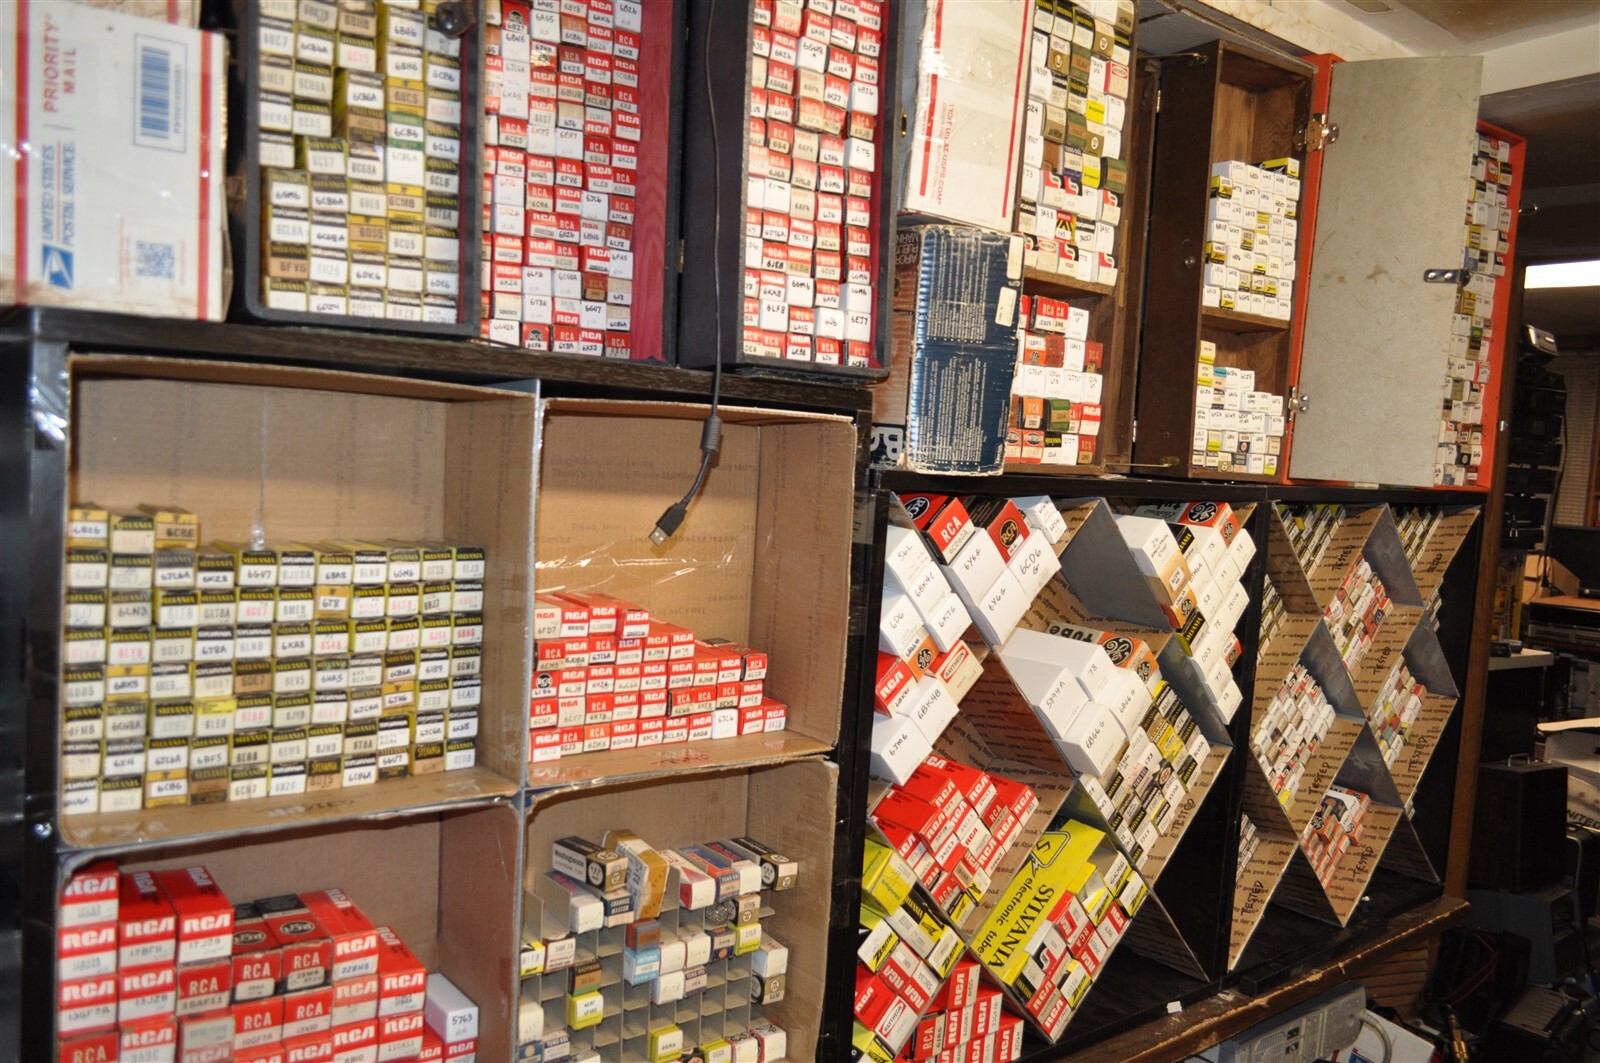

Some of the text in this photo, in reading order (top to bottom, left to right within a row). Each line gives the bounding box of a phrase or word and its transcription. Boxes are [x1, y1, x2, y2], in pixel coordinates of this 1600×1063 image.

[810, 12, 830, 24] RCA
[590, 25, 611, 38] RCA
[775, 36, 796, 47] RCA
[43, 18, 60, 113] PRIORITY
[588, 55, 609, 67] RCA
[615, 59, 635, 71] RCA
[62, 48, 76, 94] MAIL
[532, 70, 556, 81] RCA
[560, 73, 582, 85] RCA
[531, 99, 554, 111] RCA
[586, 123, 609, 134] RCA
[501, 149, 523, 160] RCA
[531, 157, 553, 168] RCA
[42, 144, 54, 240] UNITED STATES
[62, 140, 75, 246] POSTAL SERVICE
[1056, 306, 1064, 317] CA
[941, 516, 962, 543] RCA
[627, 613, 648, 621] RCA
[565, 643, 587, 651] RCA
[672, 663, 692, 672] RCA
[1373, 647, 1391, 674] TESTED
[591, 667, 612, 676] RCA
[619, 667, 640, 675] RCA
[880, 671, 904, 699] RCA
[614, 723, 635, 733] RCA
[642, 721, 662, 730] RCA
[667, 718, 686, 727] RCA
[693, 716, 712, 725] RCA
[536, 734, 559, 744] RCA
[927, 756, 946, 768] CA
[1308, 761, 1329, 795] TESTED
[935, 780, 955, 807] RCA
[969, 775, 989, 801] RCA
[1013, 789, 1032, 814] RCA
[926, 812, 946, 840] RCA
[996, 815, 1015, 840] RCA
[1567, 809, 1600, 829] NITED
[1353, 846, 1374, 879] TESTED
[64, 877, 117, 896] RCA
[997, 877, 1033, 927] electronic
[1241, 880, 1264, 916] TESTED
[125, 917, 175, 938] RCA
[183, 914, 231, 933] RCA
[988, 884, 1054, 968] SYLVANIA
[62, 928, 115, 949] RCA
[336, 936, 376, 955] RCA
[124, 970, 173, 992] RCA
[882, 965, 904, 989] RCA
[62, 980, 115, 1002] RCA
[905, 984, 925, 1008] RCA
[1034, 980, 1051, 1010] RCA
[452, 1014, 472, 1025] 5763
[1044, 999, 1064, 1030] RCA
[121, 1028, 173, 1047] RCA
[334, 1027, 375, 1046] RCA
[289, 1043, 332, 1062] RCA
